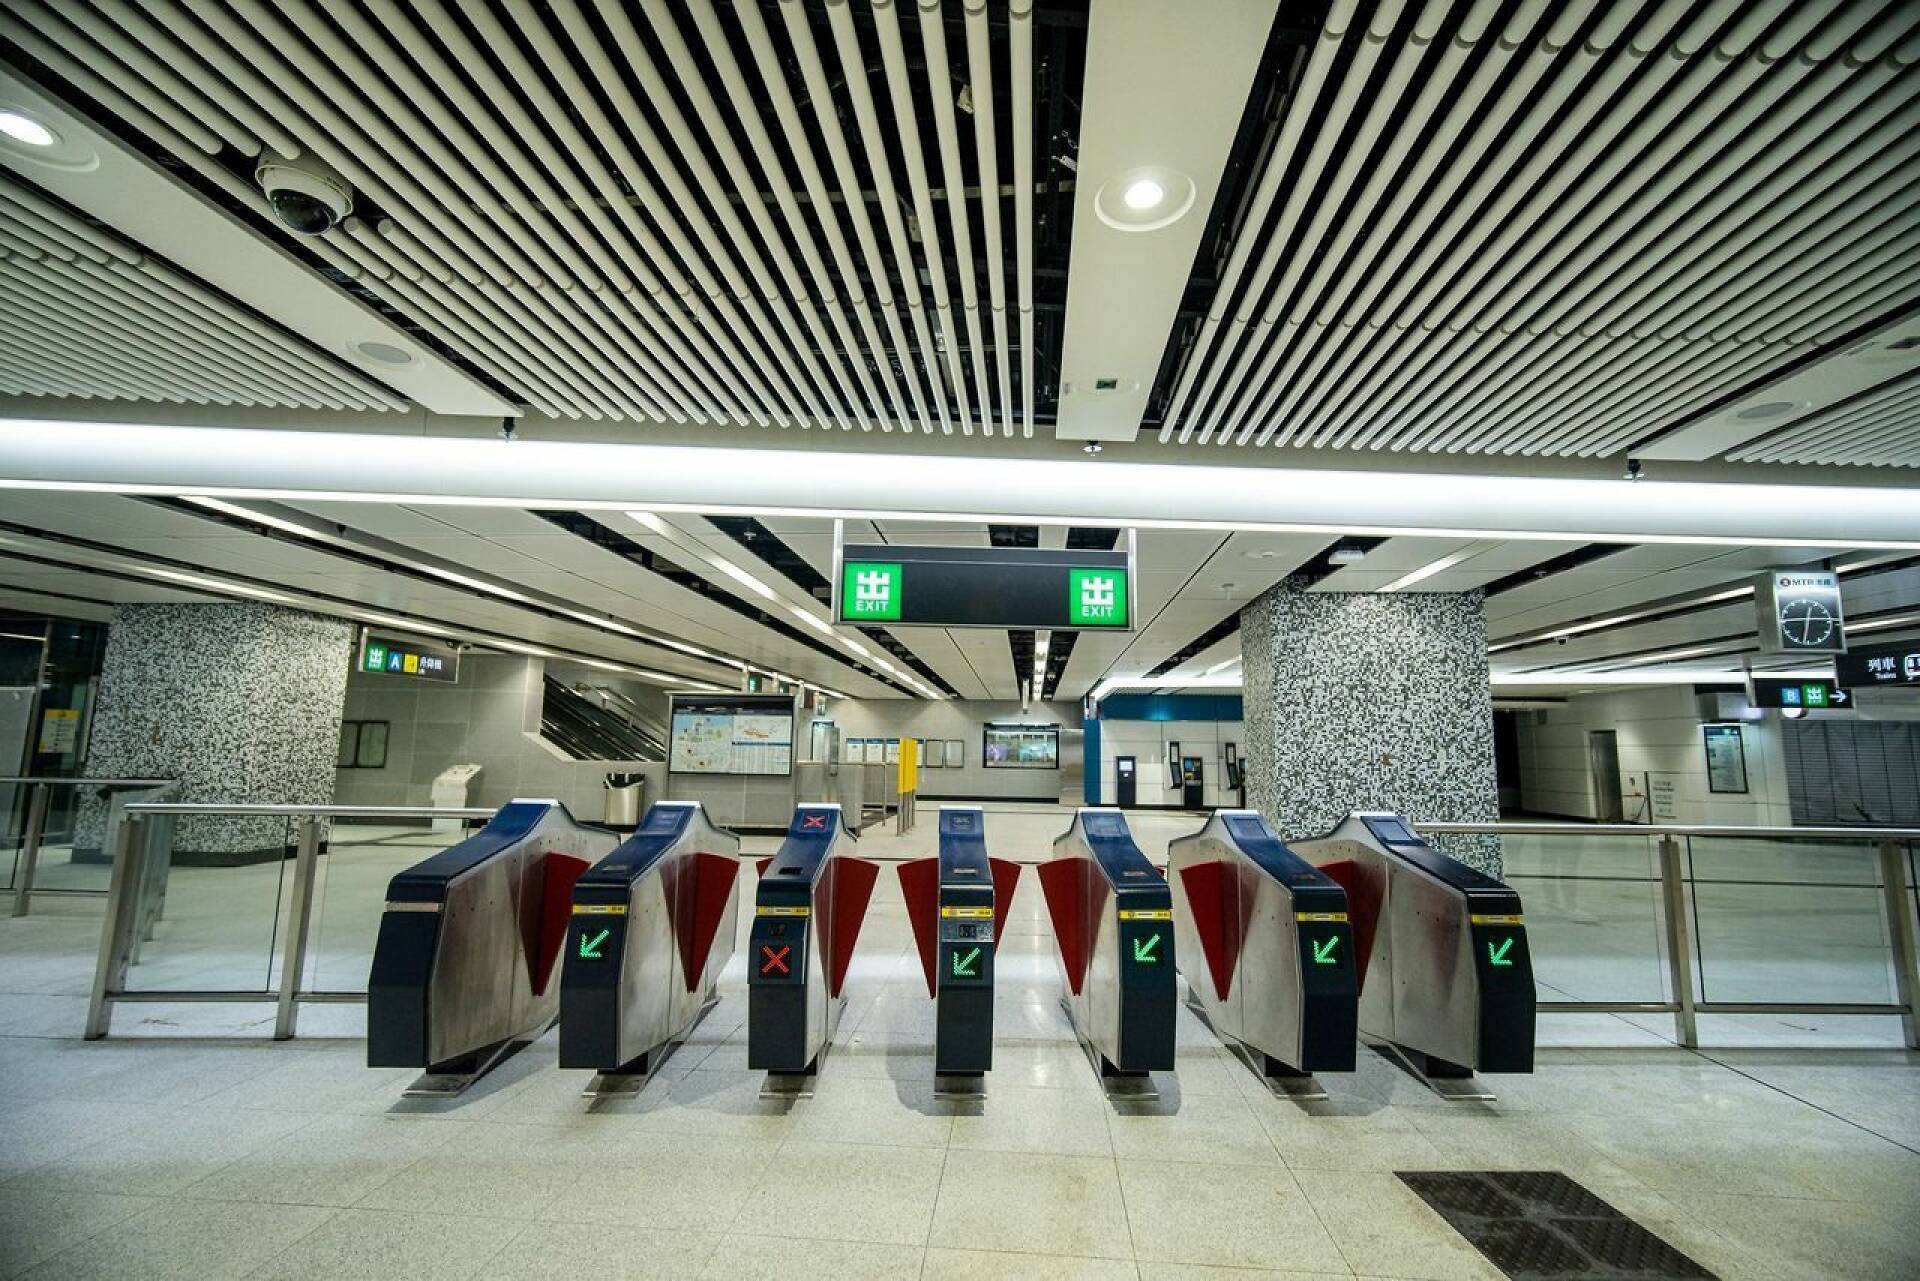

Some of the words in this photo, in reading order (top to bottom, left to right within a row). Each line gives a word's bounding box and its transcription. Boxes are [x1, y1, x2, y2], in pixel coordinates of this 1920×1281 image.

[856, 600, 889, 612] EXIT
[1082, 605, 1114, 617] EXIT
[391, 655, 400, 669] A
